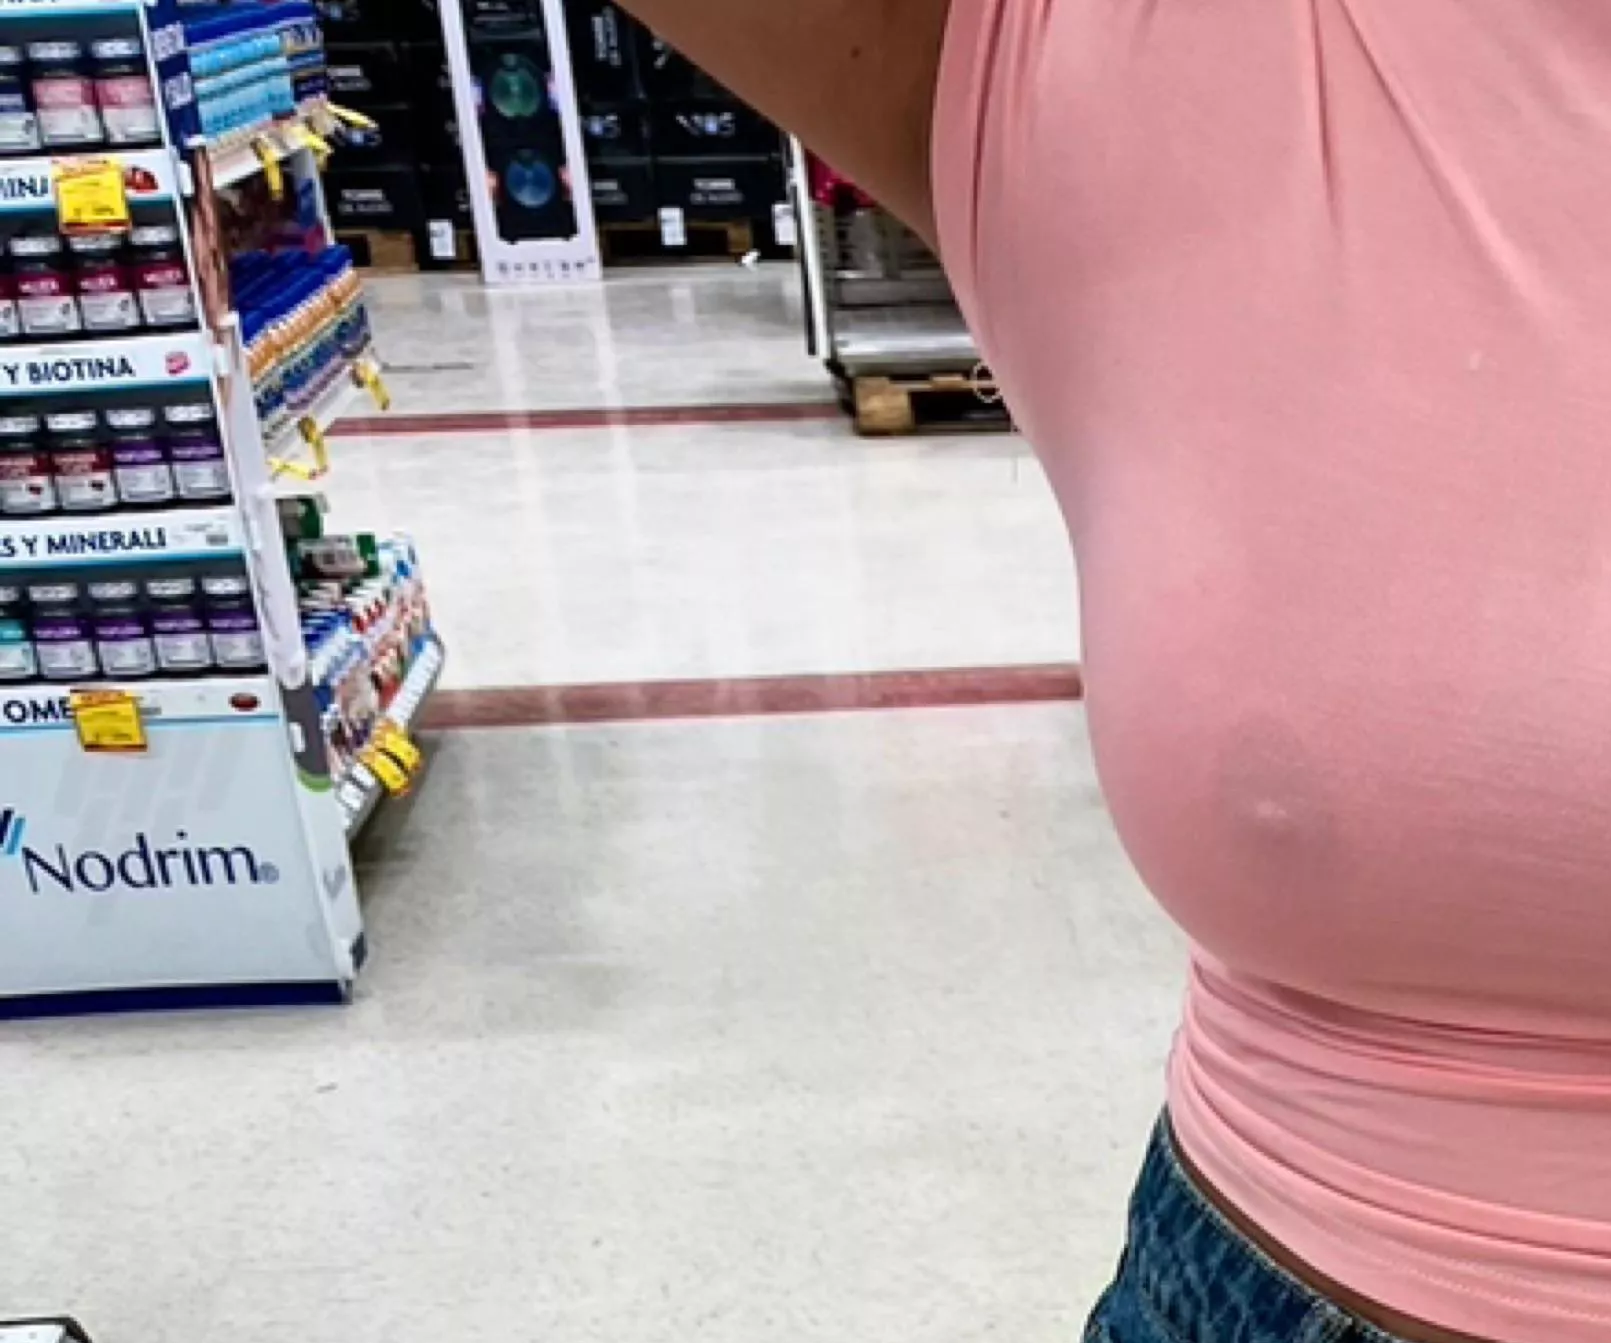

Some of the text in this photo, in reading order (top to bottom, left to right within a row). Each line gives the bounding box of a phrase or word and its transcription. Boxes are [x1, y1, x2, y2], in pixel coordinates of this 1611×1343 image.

[26, 354, 136, 385] BIOTINA
[22, 534, 37, 557] Y
[22, 831, 259, 895] Nodrim
